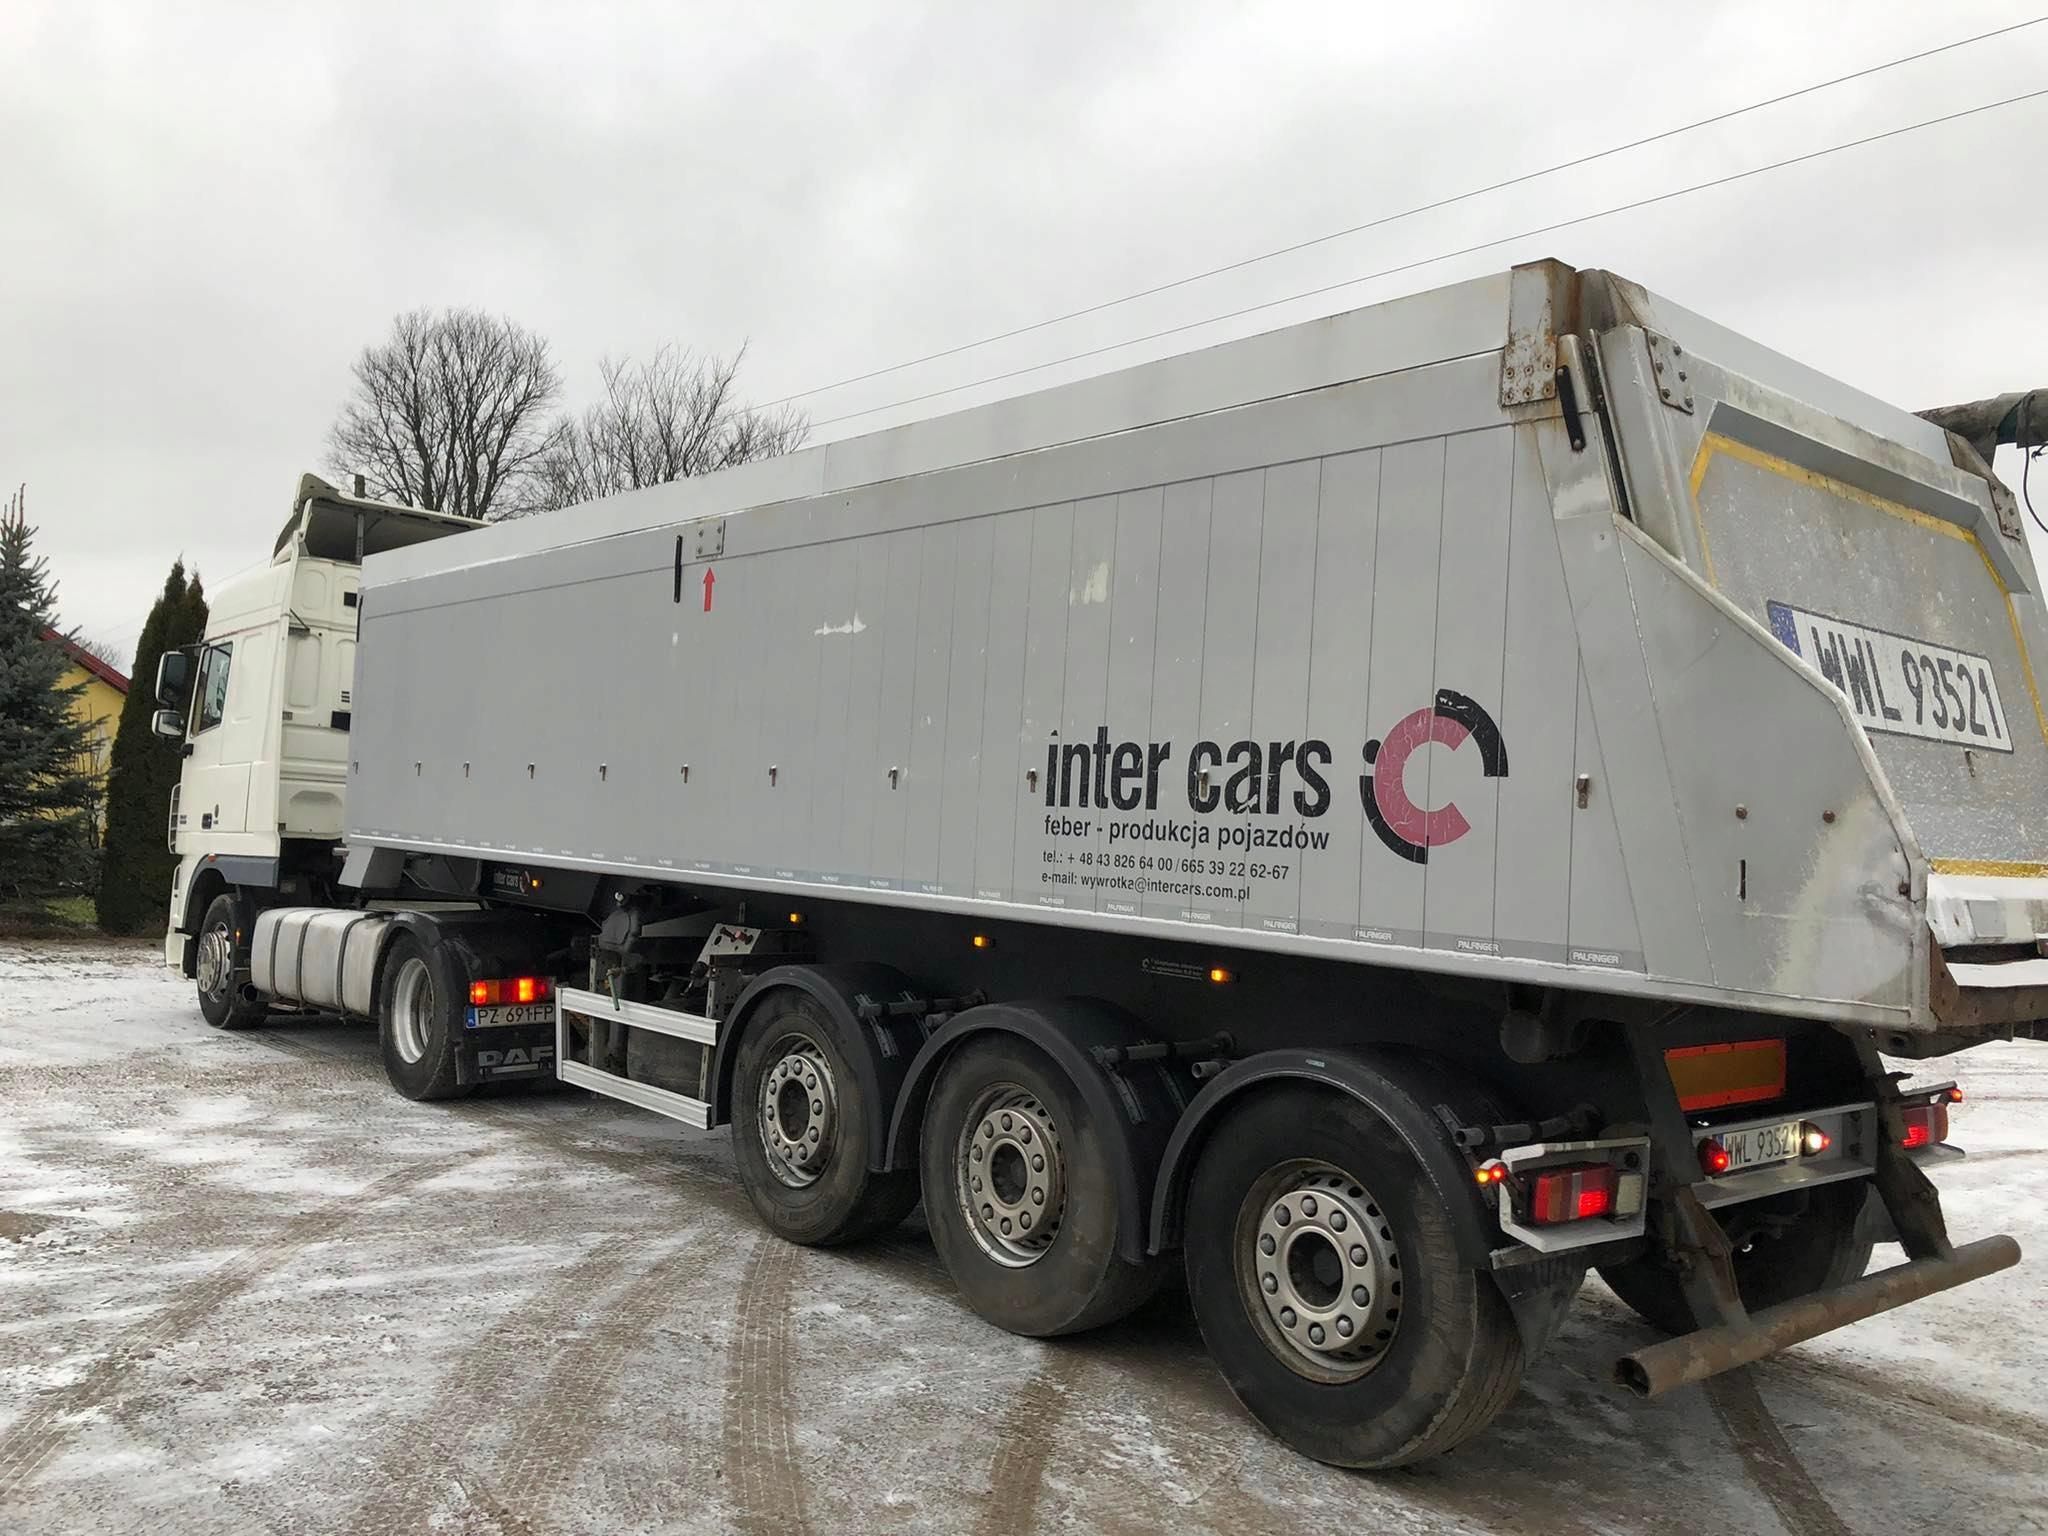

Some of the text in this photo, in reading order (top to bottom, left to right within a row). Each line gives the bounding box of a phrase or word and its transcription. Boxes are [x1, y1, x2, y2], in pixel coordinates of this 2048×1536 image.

[1811, 626, 2002, 740] WWL 93521
[1045, 726, 1333, 818] inter cars
[1044, 814, 1091, 837] feber
[1108, 818, 1210, 850] produkcja
[1217, 821, 1330, 852] pojazdów
[1043, 850, 1063, 864] tel.:
[1079, 852, 1093, 866] 48
[1096, 853, 1110, 867] 43
[1113, 854, 1136, 869] 826
[1139, 856, 1154, 870] 64
[1208, 860, 1225, 876] 39
[1228, 862, 1246, 877] 22
[1249, 863, 1290, 880] 62-67
[1041, 871, 1251, 902] e-mail: wywrotka@intercars.com.pl
[1263, 919, 1297, 931] PALFINGER
[1355, 930, 1393, 942] PALFINGER
[1457, 940, 1500, 953] PALFINGER
[1572, 952, 1620, 965] PALFINGER
[478, 1008, 499, 1025] PZ
[478, 1045, 554, 1068] DAF
[1725, 1124, 1798, 1166] WWL 93521
